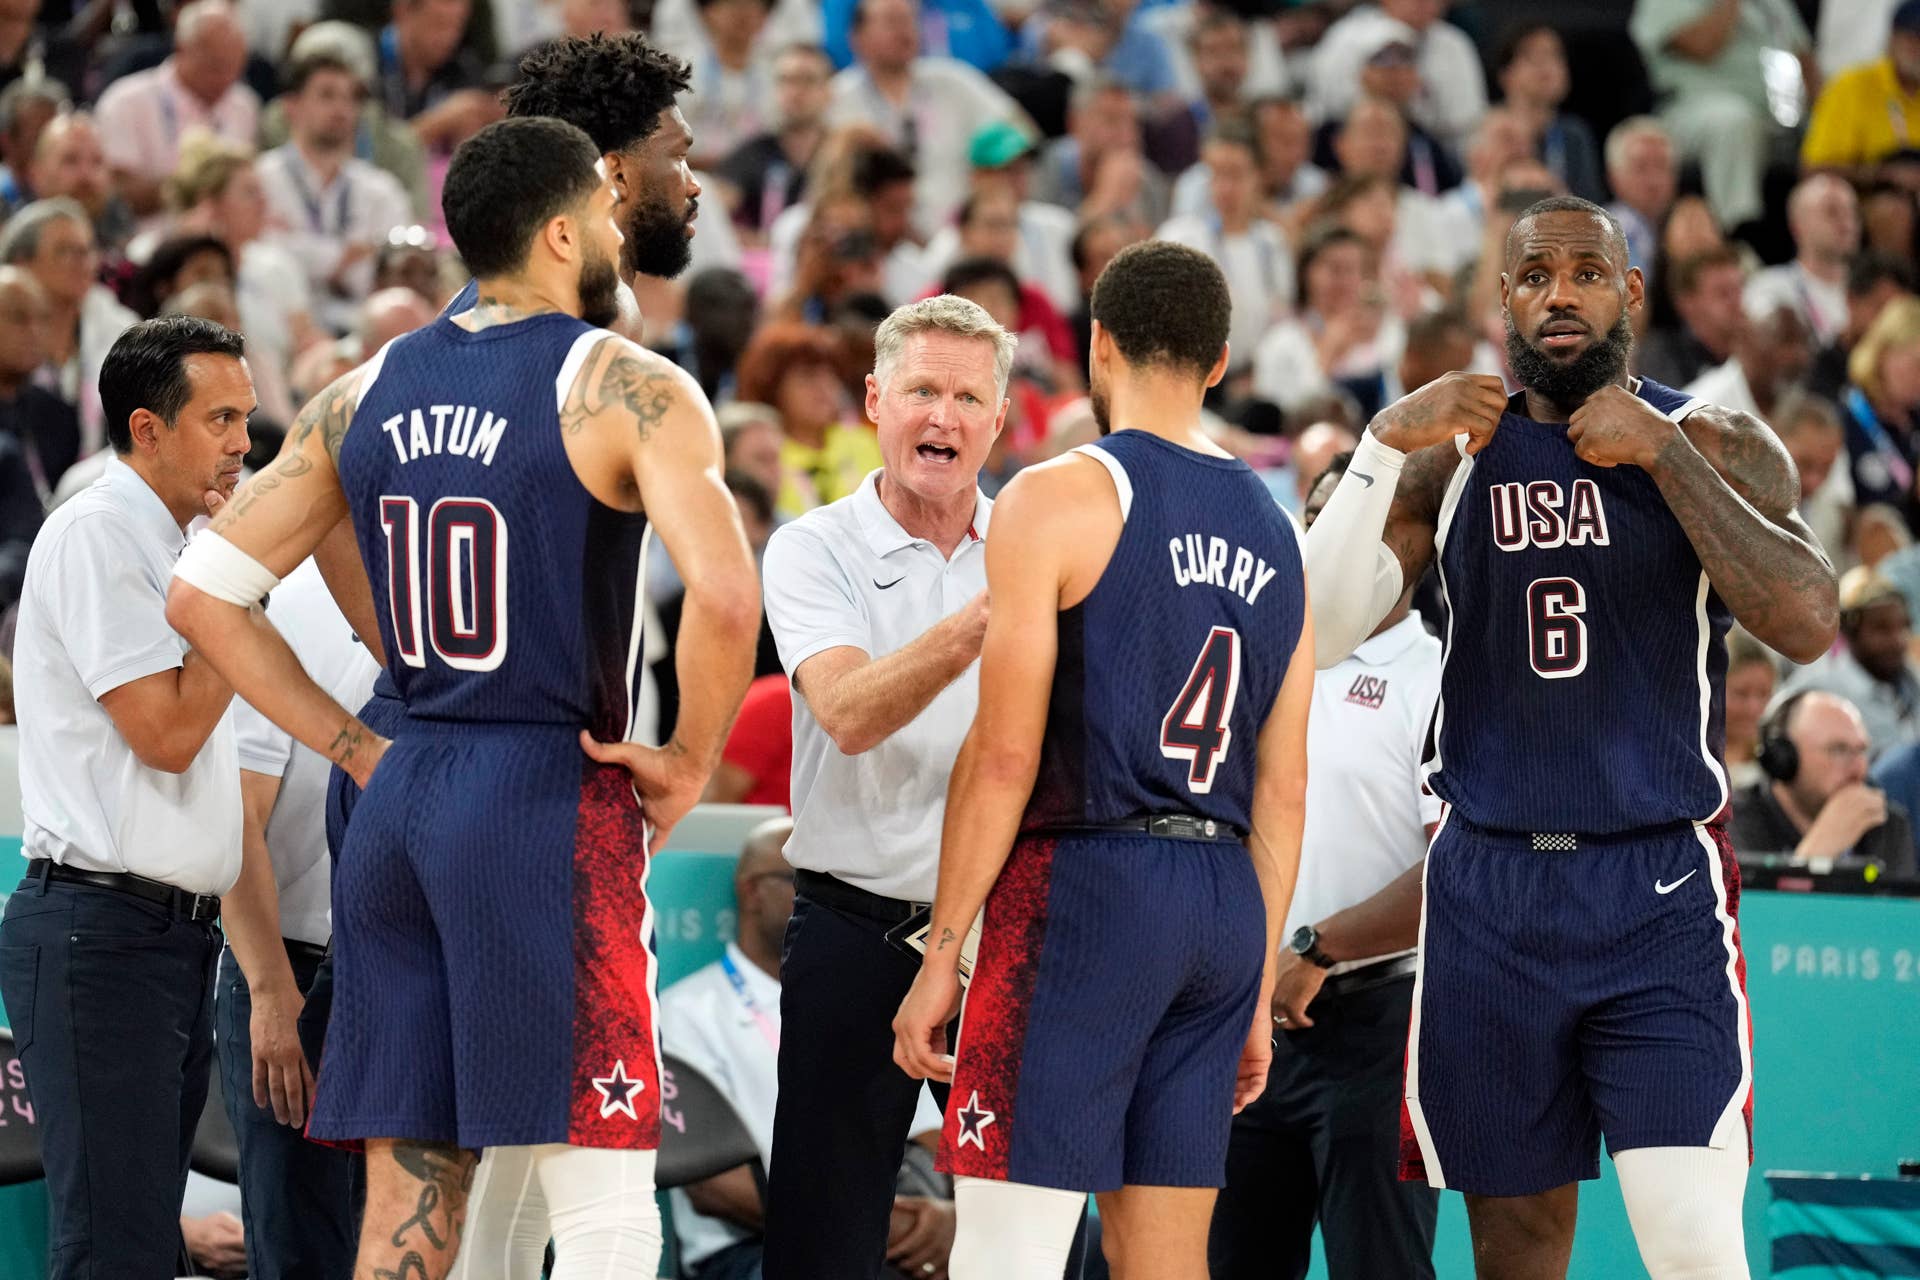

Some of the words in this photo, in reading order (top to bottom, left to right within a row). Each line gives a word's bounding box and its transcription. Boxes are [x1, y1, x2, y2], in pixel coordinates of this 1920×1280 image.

[382, 405, 508, 466] TATUM
[1490, 479, 1610, 552] USA
[379, 496, 508, 672] 10
[1169, 534, 1277, 606] CURRY
[1527, 576, 1587, 679] 6
[1160, 625, 1241, 794] 4
[1349, 674, 1388, 704] USA
[1771, 944, 1880, 980] PARIS
[1893, 949, 1920, 982] 2
